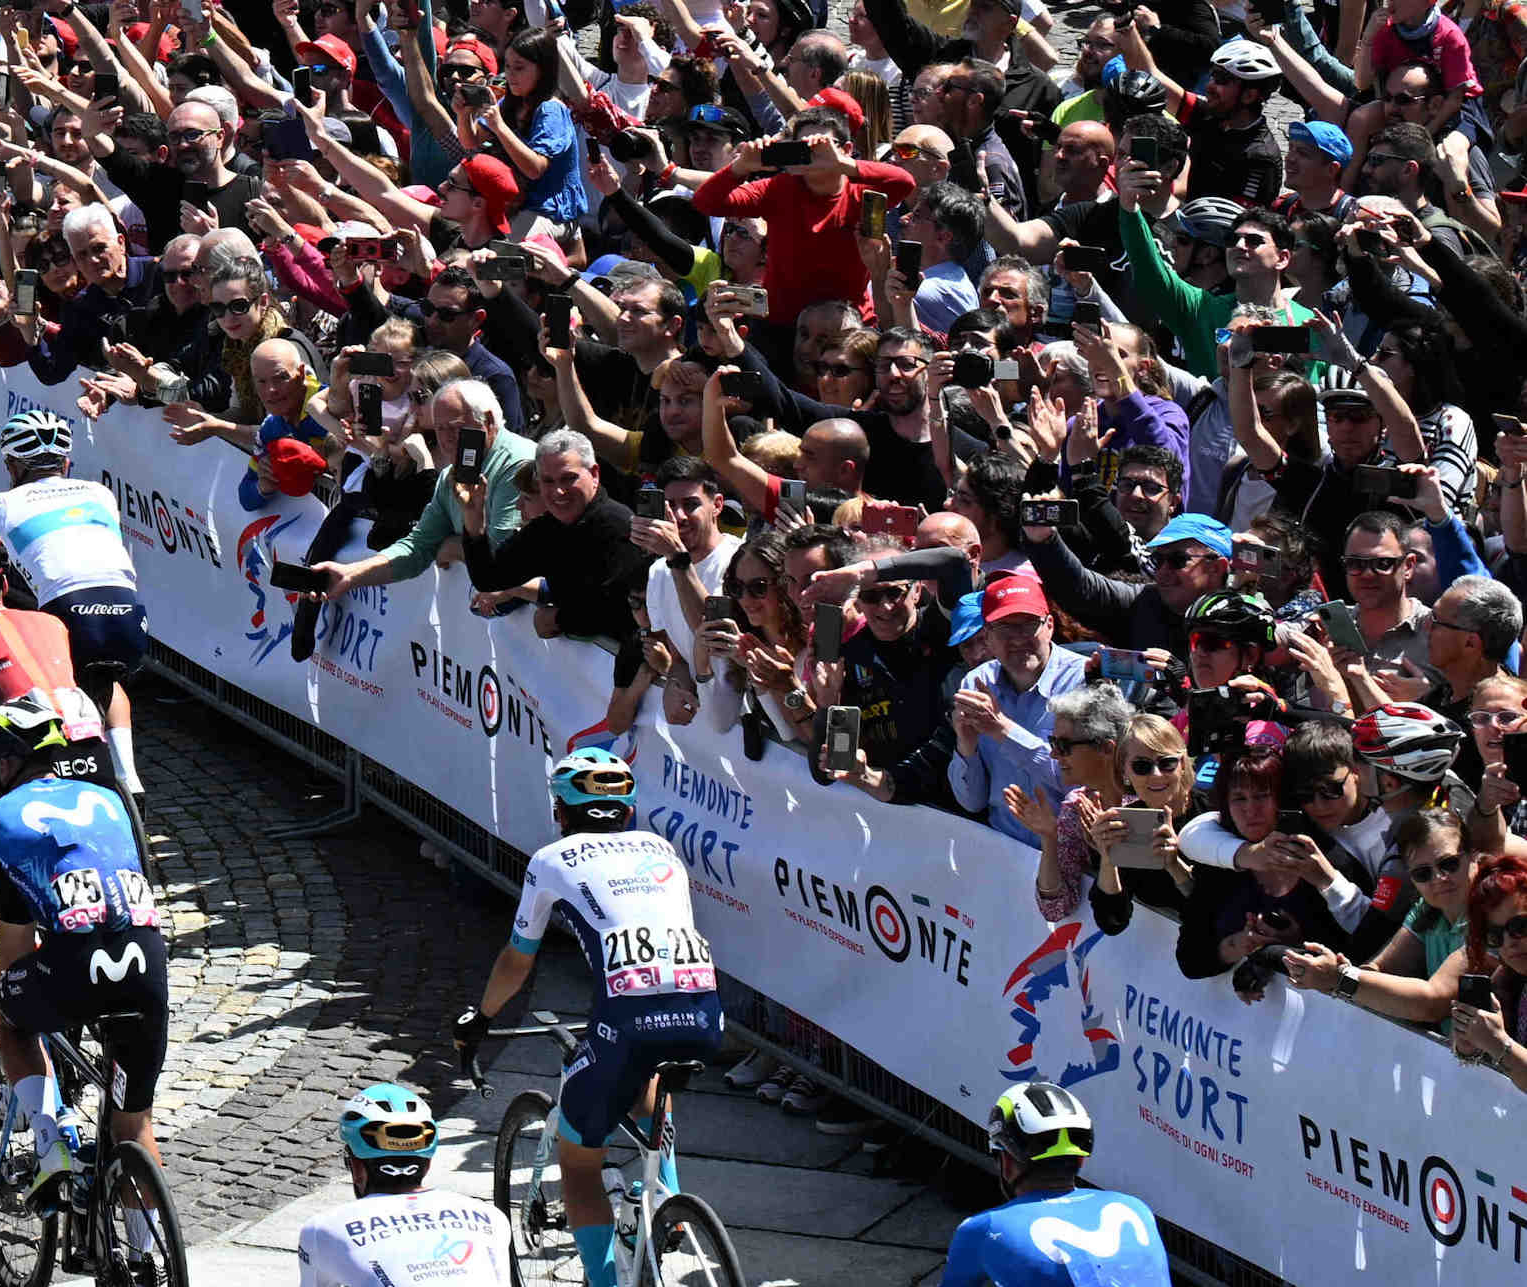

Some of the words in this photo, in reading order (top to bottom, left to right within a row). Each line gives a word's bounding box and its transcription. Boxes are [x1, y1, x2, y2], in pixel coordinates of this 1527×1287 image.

[70, 603, 133, 616] Wilier
[317, 601, 385, 673] SPORT
[360, 680, 386, 699] SPORT
[410, 640, 554, 758] PIEMONTE
[662, 753, 754, 830] PIEMONTE
[648, 806, 741, 889] SPORT
[607, 875, 650, 889] Bapco
[612, 882, 667, 897] energies
[724, 891, 751, 917] SPORT
[773, 856, 973, 987] PIEMONTE
[799, 912, 820, 933] PLACE
[820, 922, 829, 936] TO
[828, 926, 866, 956] EXPERIENCE
[604, 925, 656, 971] 218
[634, 1011, 696, 1025] BAHRAIN
[1124, 983, 1243, 1079] PIEMONTE
[1132, 1045, 1249, 1145] SPORT
[1138, 1103, 1155, 1125] NEL
[1154, 1111, 1181, 1144] CUORE
[1183, 1131, 1193, 1151] DI
[1194, 1139, 1219, 1164] OGNI
[1221, 1151, 1255, 1181] SPORT
[1298, 1112, 1527, 1265] PIEMONT
[1306, 1171, 1323, 1193] THE
[1323, 1179, 1350, 1205] PLACE
[1351, 1192, 1363, 1210] TO
[1363, 1198, 1410, 1234] EXPERIENCE
[345, 1208, 492, 1237] BAHRAIN
[351, 1219, 494, 1248] VICTORIOUS
[406, 1260, 449, 1274] Bapco
[413, 1265, 469, 1283] energies
